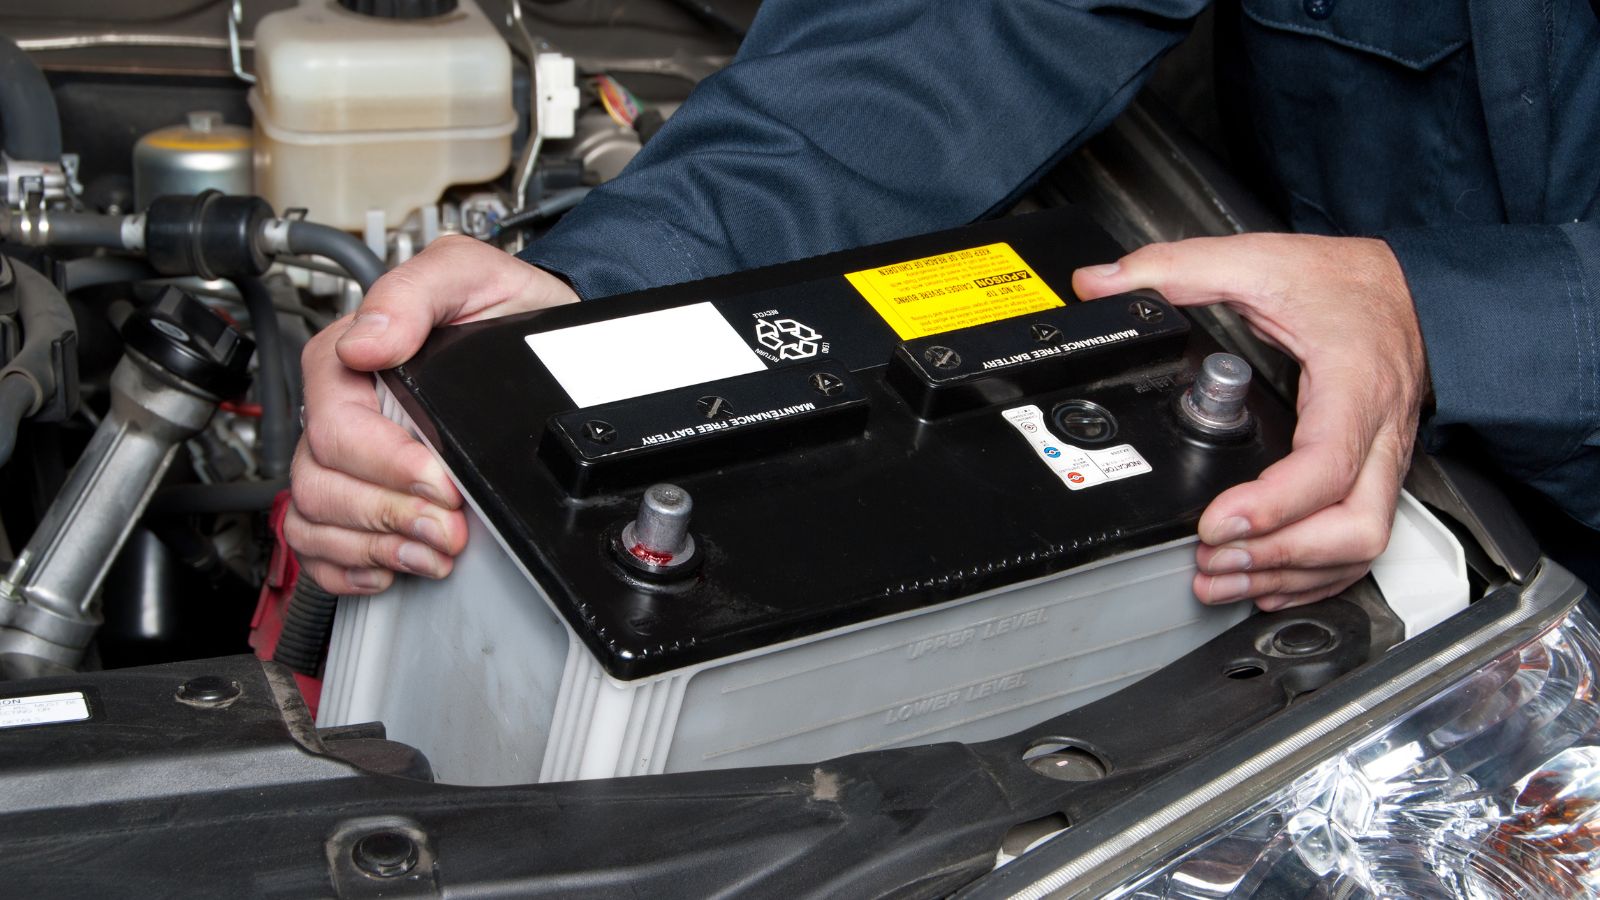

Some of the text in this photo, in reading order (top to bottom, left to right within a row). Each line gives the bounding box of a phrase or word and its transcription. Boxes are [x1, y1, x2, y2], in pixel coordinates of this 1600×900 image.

[946, 254, 959, 262] OF
[956, 251, 975, 260] OUT
[971, 248, 992, 257] KEEP
[911, 261, 925, 269] OF
[922, 256, 949, 267] REACH
[876, 263, 914, 276] CHILDREN
[975, 272, 1020, 287] POISON
[943, 282, 974, 293] CAUSES
[996, 286, 1014, 295] NOT
[1011, 283, 1026, 291] DO
[892, 293, 920, 304] BURNS
[917, 288, 946, 299] SEVERE
[983, 289, 998, 298] TIP
[752, 309, 779, 319] RECYCLE
[982, 329, 1139, 369] MAINTENANCE FREE BATTERY
[754, 348, 780, 363] RETURN
[641, 402, 815, 446] MAINTENANCE FREE BATTERY
[1104, 459, 1142, 474] INDICATOR
[908, 608, 1048, 660] UPPER LEVEL
[884, 672, 1030, 724] LOWER LEVEL
